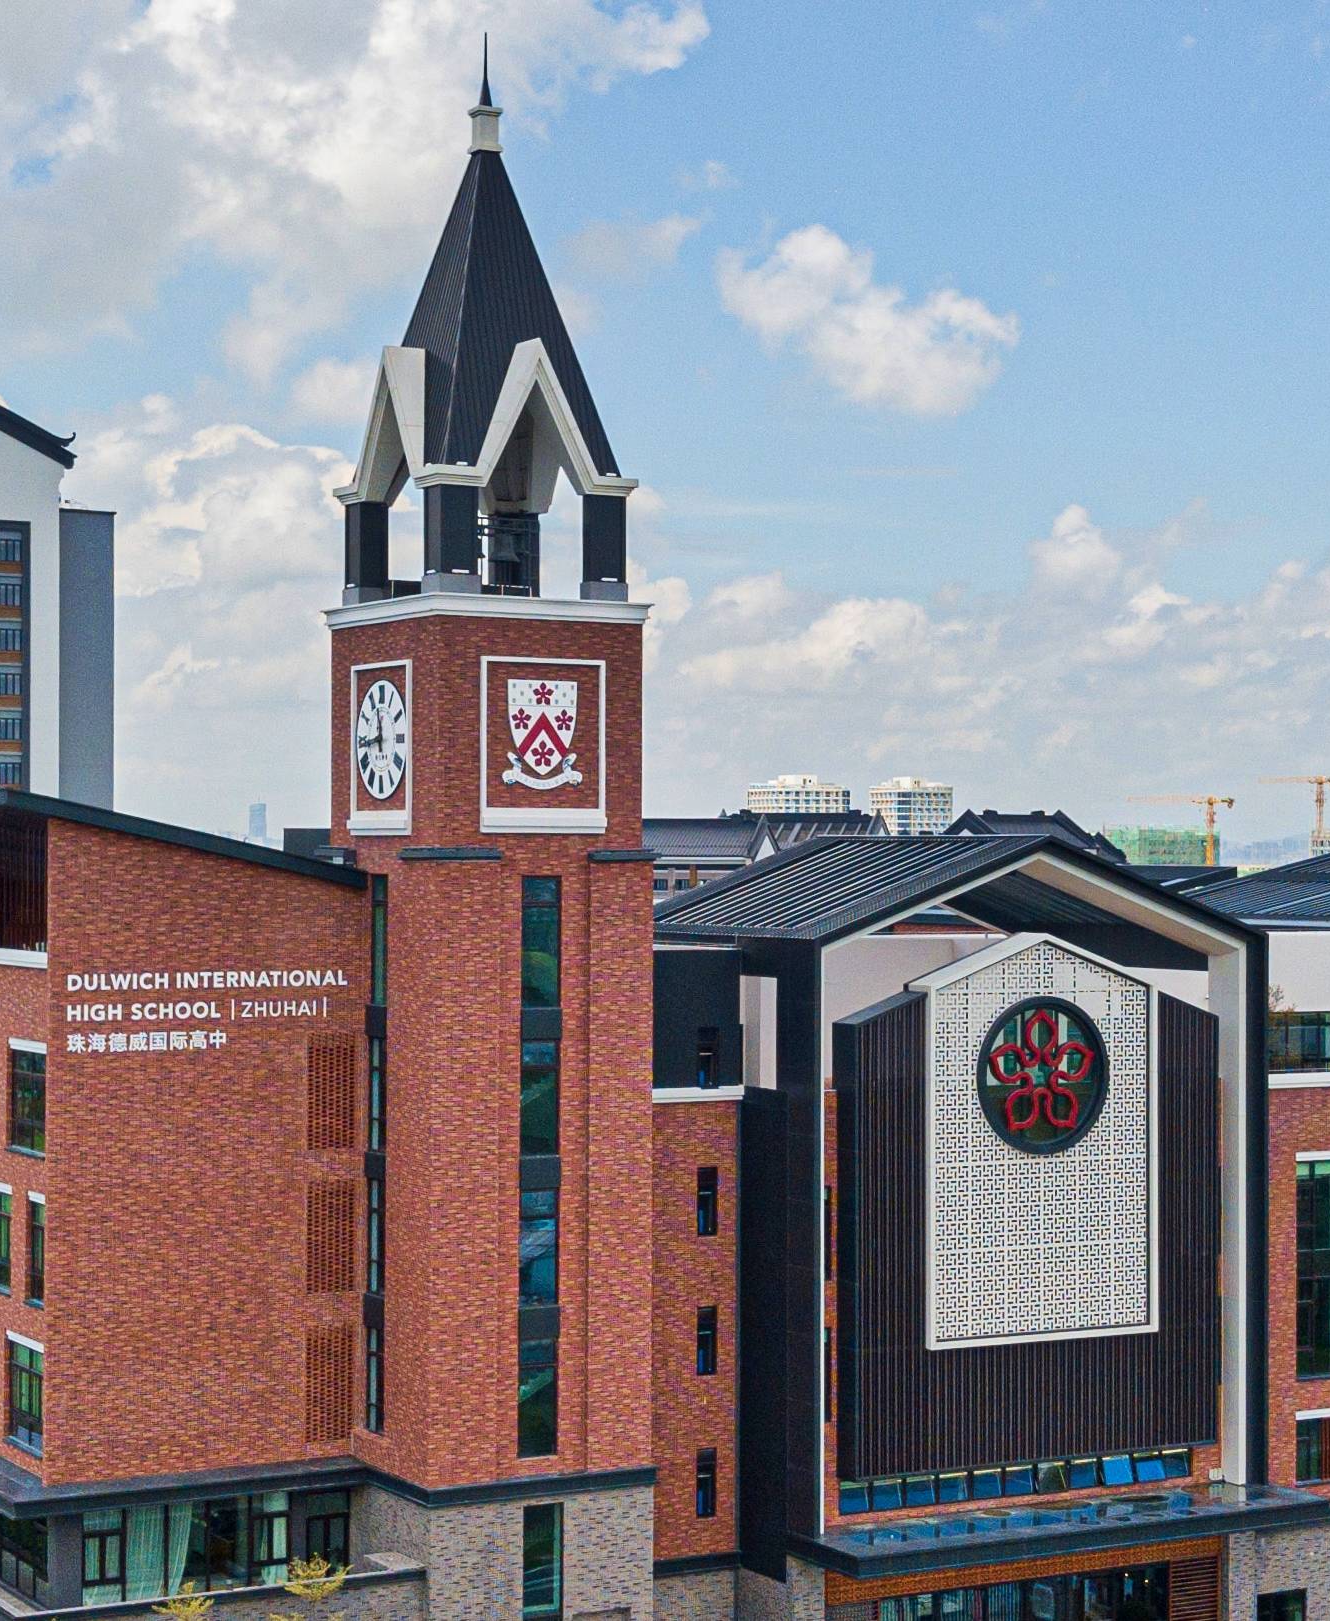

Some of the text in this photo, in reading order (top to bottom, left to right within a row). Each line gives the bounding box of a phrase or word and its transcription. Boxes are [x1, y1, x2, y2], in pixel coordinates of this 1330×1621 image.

[66, 969, 348, 991] DULWICH INTERNATIONAL
[66, 1003, 123, 1021] HIGH
[130, 1001, 222, 1020] SCHOOL
[66, 1029, 227, 1054] 珠海德威国际高中
